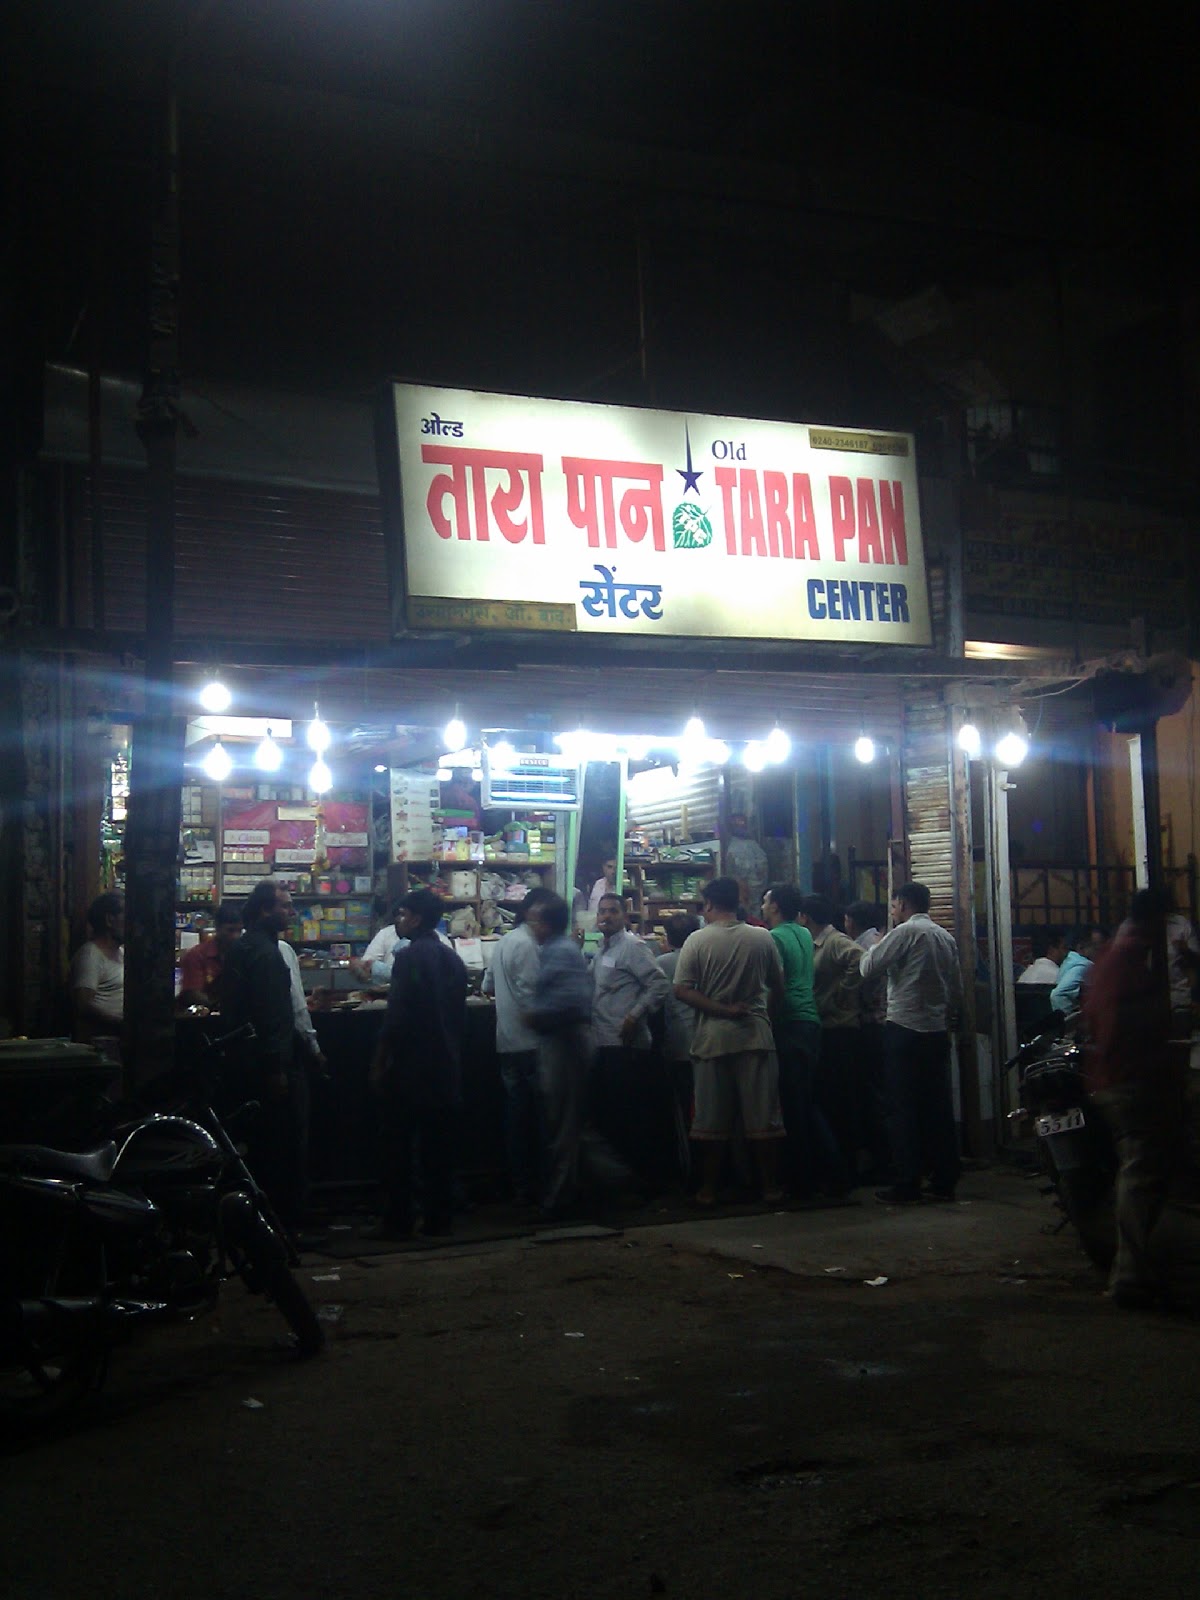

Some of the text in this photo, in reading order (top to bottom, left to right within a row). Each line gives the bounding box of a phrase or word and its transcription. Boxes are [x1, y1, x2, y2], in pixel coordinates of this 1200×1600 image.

[420, 411, 464, 438] ओल्ड
[711, 440, 747, 461] Old
[421, 444, 666, 552] तारा पान
[714, 466, 909, 566] TARA PAN
[579, 564, 664, 620] सेंटर
[806, 578, 911, 623] CENTER
